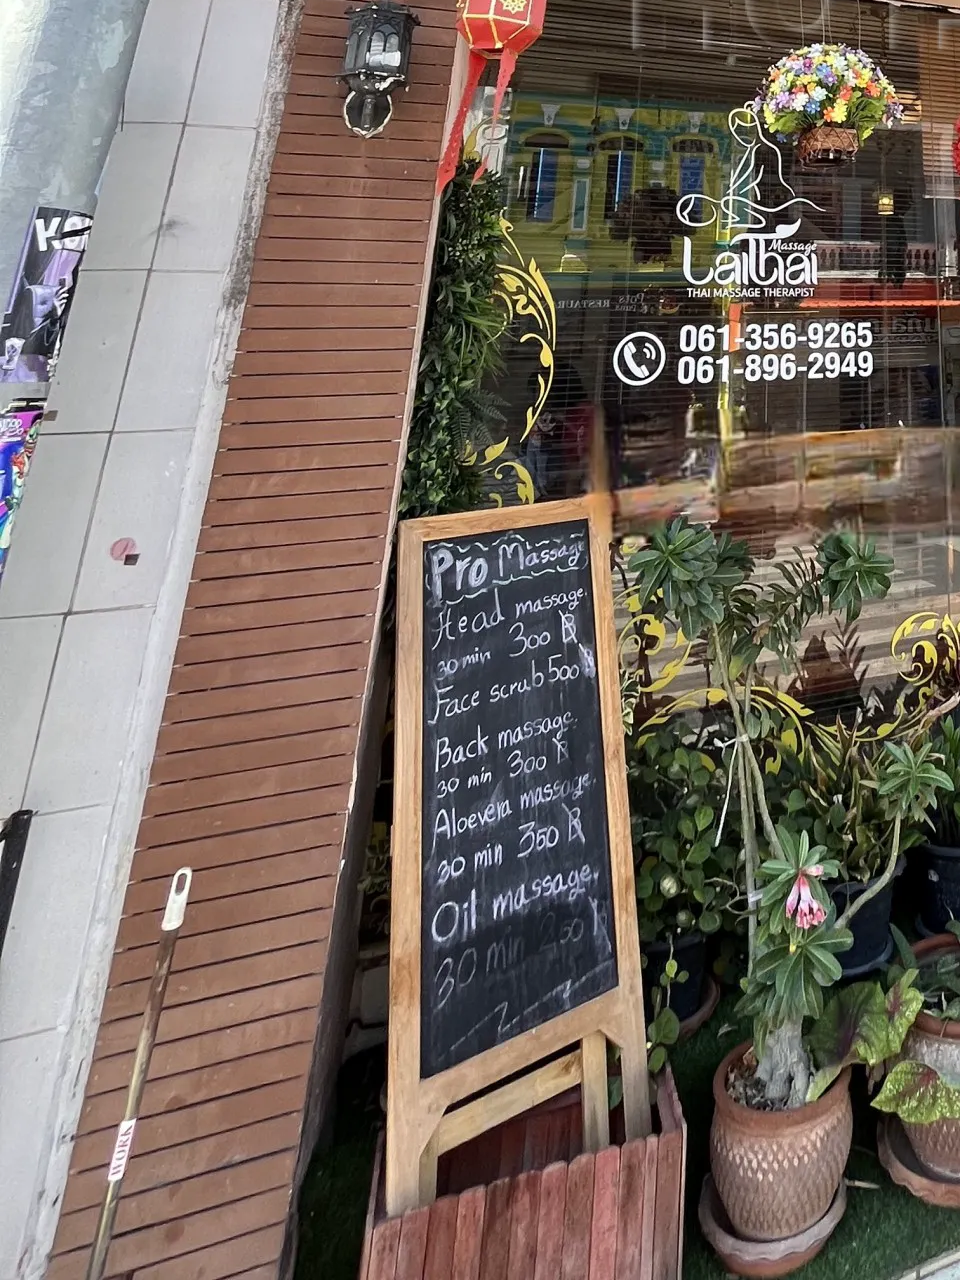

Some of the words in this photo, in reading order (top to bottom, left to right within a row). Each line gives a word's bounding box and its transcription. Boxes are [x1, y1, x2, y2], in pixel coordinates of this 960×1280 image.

[768, 240, 817, 256] Massage
[687, 288, 710, 298] THAI
[713, 287, 760, 298] MASSAGE
[763, 287, 815, 297] THERAPIST
[679, 322, 873, 353] 061-356-9265
[677, 351, 874, 384] 061-896-2949
[431, 548, 489, 600] Pro
[499, 541, 585, 577] Massage
[432, 587, 505, 650] Head
[437, 658, 458, 681] 30
[462, 647, 491, 665] min
[509, 622, 551, 657] 300
[428, 685, 480, 725] Face
[489, 660, 544, 703] scrub
[548, 654, 580, 682] 500
[435, 724, 489, 773] Back
[437, 777, 460, 799] 30
[467, 767, 492, 789] min
[507, 750, 547, 778] 300
[437, 856, 466, 887] 30
[474, 843, 503, 871] min
[517, 821, 560, 857] 350
[431, 888, 477, 943] Oil
[434, 947, 477, 1011] 30
[486, 925, 525, 973] min
[111, 1124, 133, 1176] WORK
